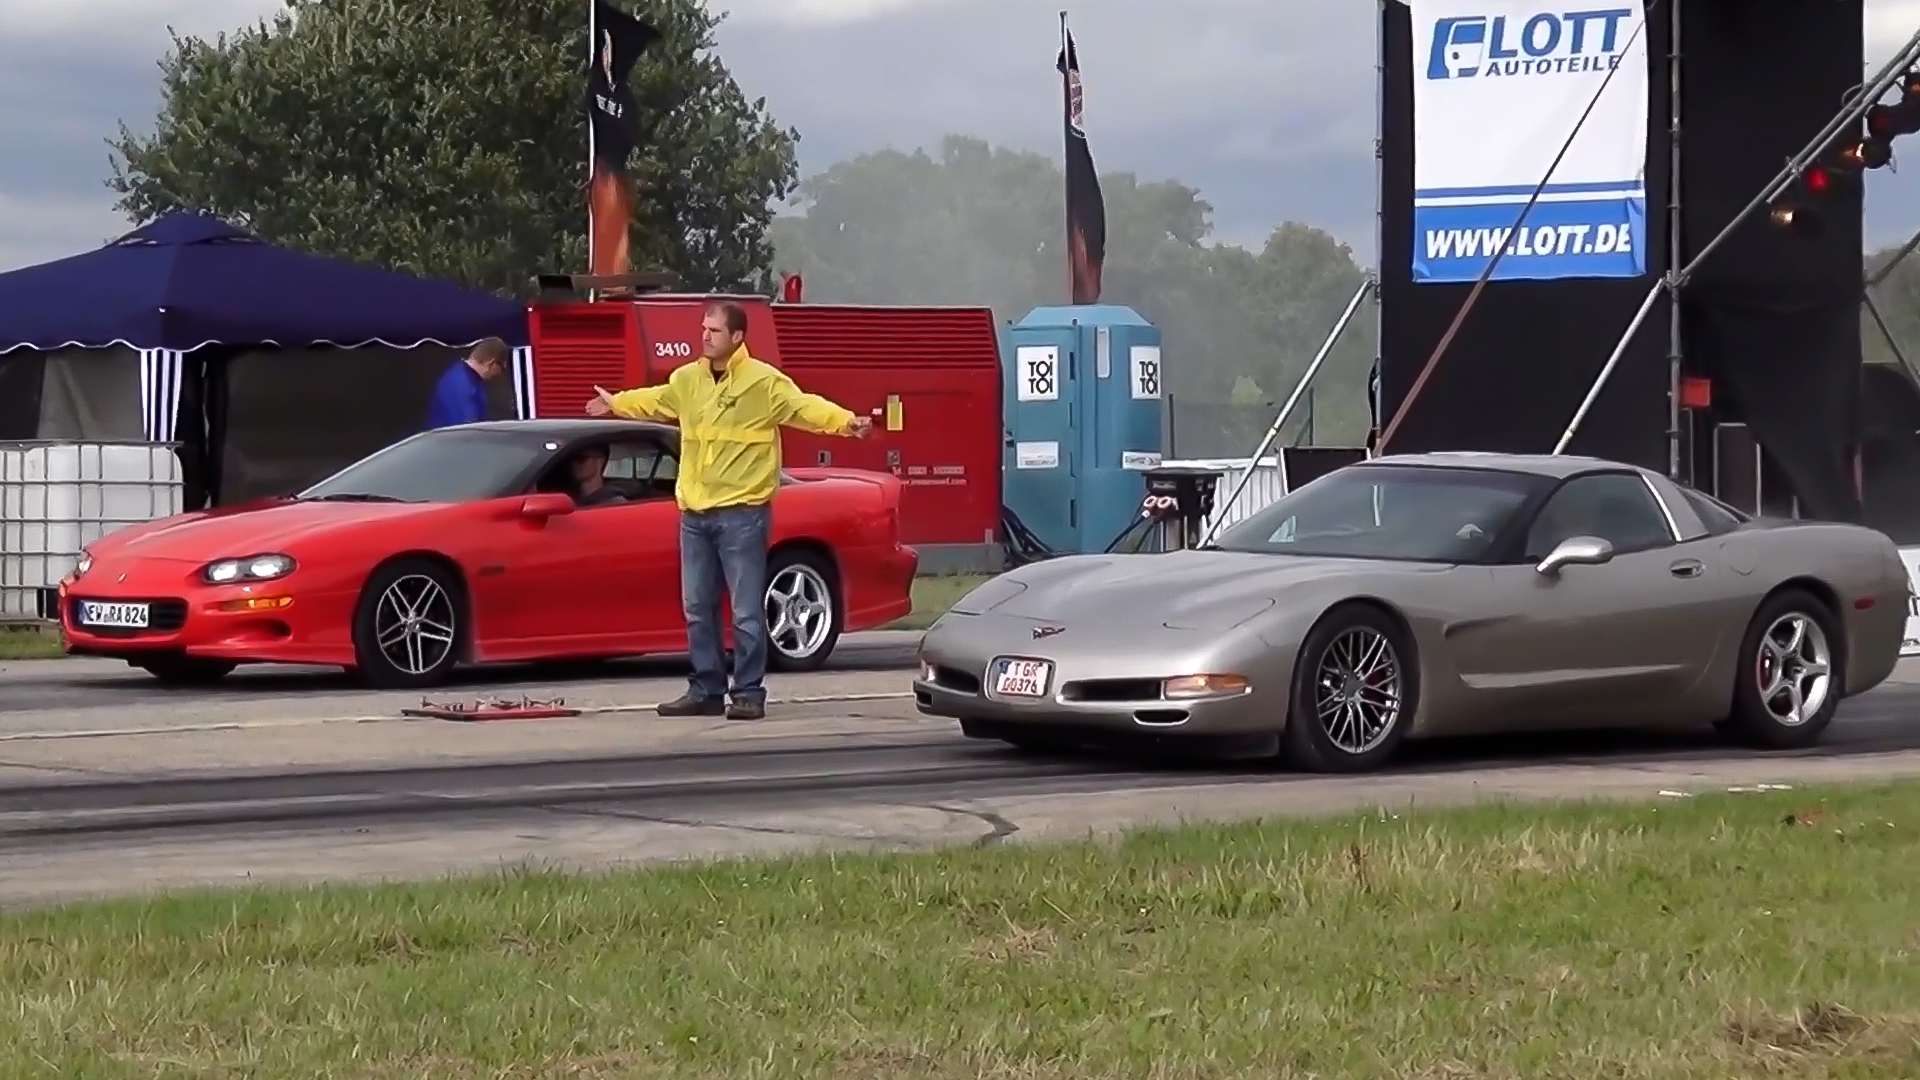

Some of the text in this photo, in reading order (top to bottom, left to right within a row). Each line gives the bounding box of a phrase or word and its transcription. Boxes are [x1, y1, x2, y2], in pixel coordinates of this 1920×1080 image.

[1488, 9, 1632, 59] LOTT
[1485, 54, 1622, 77] AUTOTEILE
[1425, 222, 1632, 259] WWW.LOTT.DE
[655, 342, 691, 357] 3410
[1028, 377, 1054, 394] TOI
